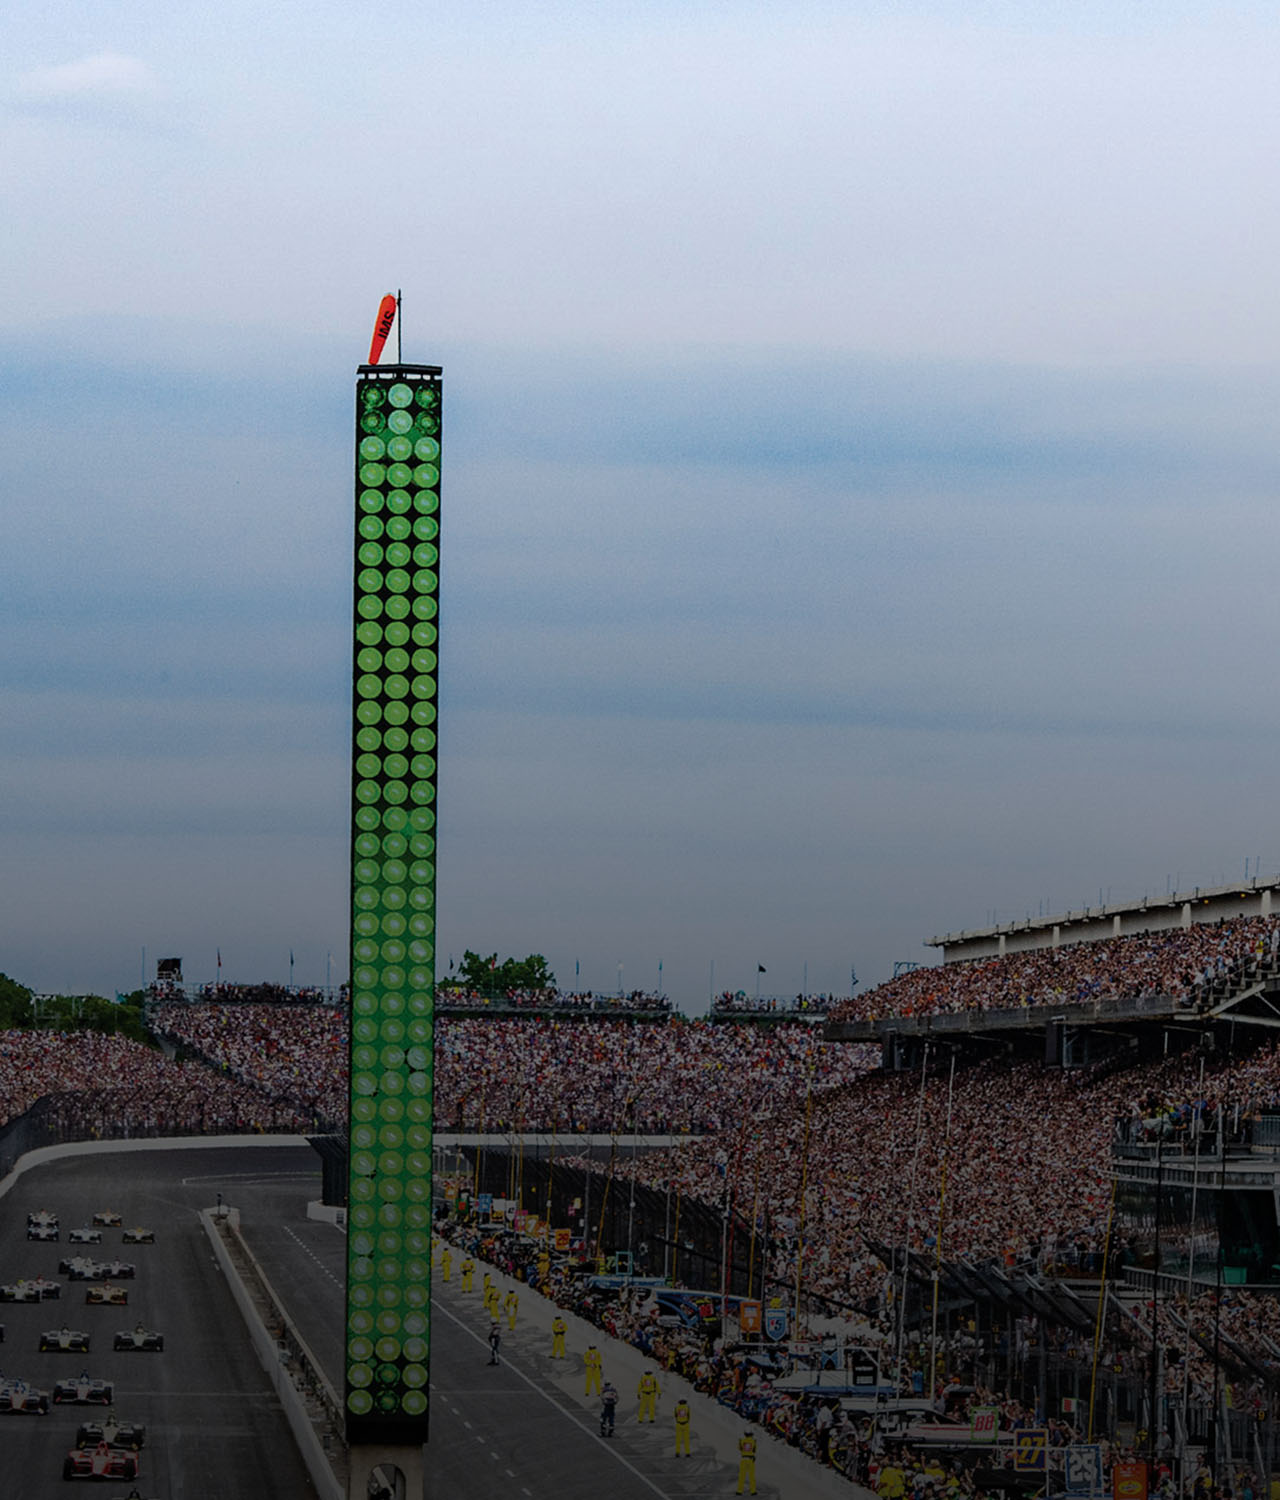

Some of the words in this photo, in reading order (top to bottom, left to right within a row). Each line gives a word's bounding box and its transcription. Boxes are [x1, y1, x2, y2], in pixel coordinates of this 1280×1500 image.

[378, 311, 395, 339] IMS
[975, 1414, 995, 1432] 88
[1257, 1411, 1265, 1421] 9
[1018, 1437, 1045, 1464] 27
[1069, 1447, 1096, 1482] 25
